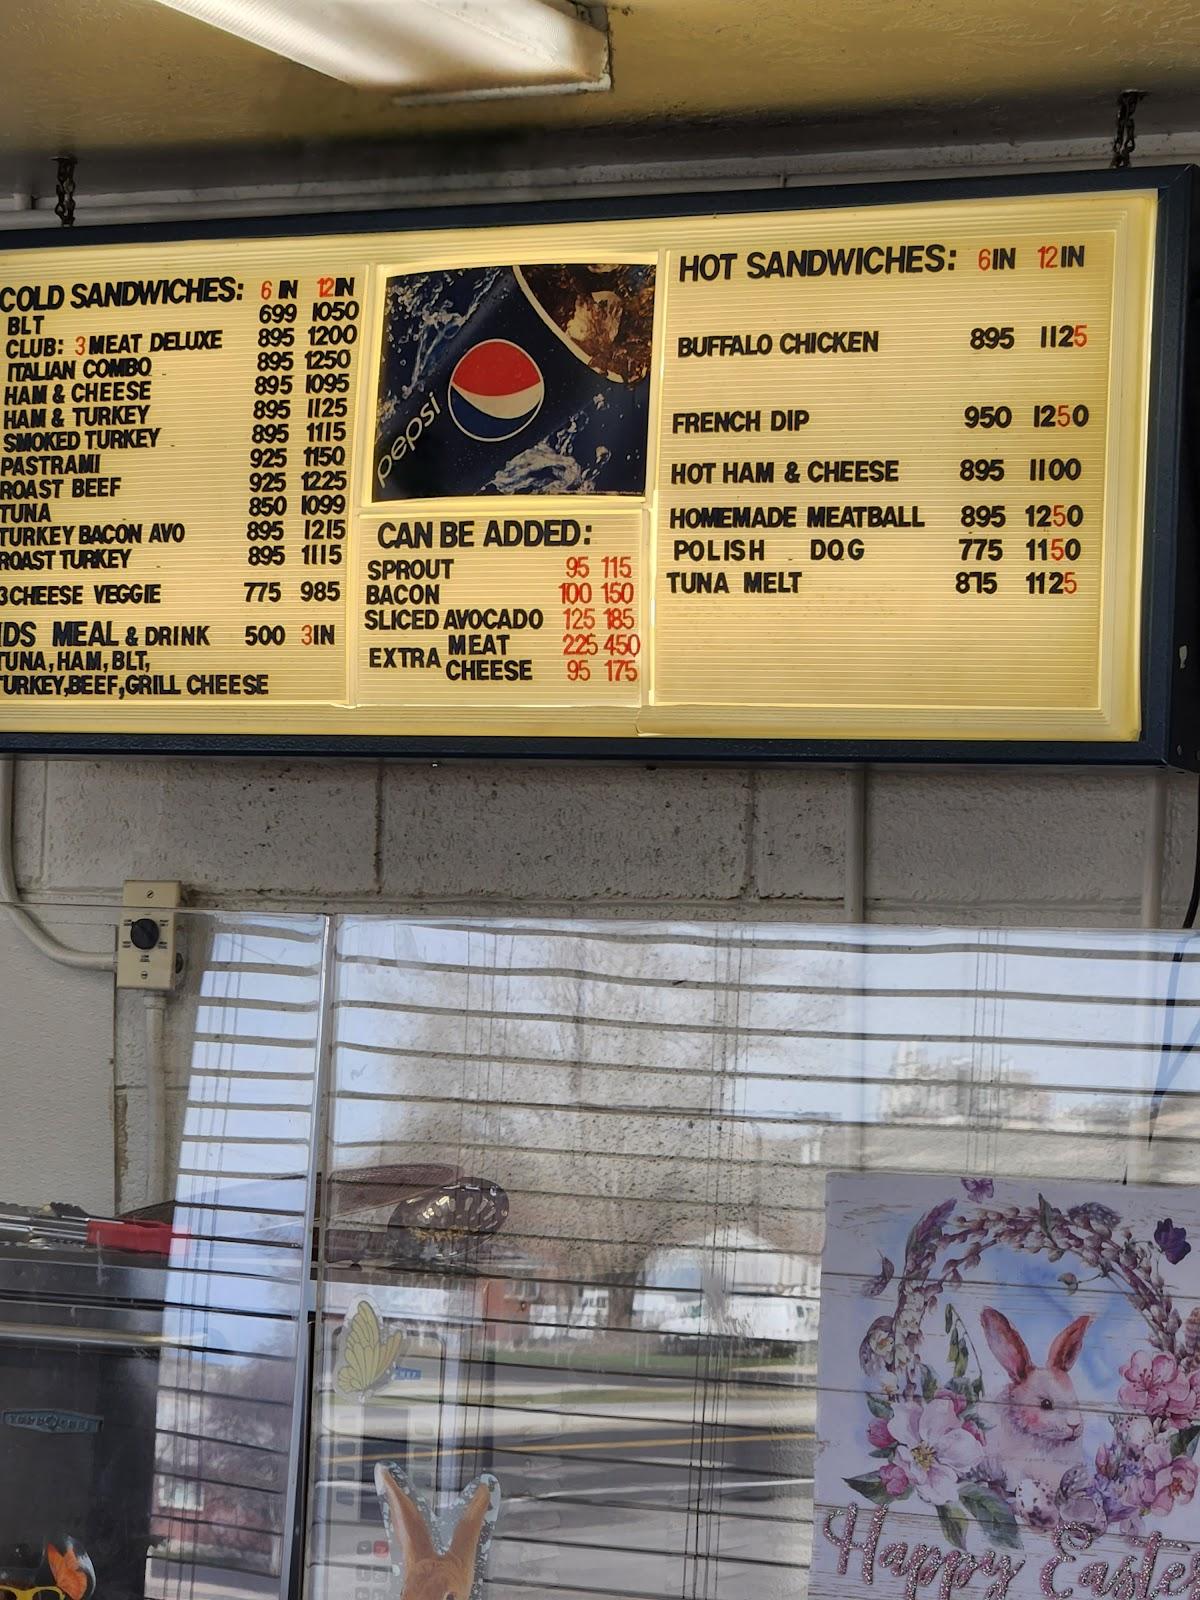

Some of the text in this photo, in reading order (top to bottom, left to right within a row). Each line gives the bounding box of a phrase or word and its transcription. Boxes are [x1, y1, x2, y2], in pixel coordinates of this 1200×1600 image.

[679, 243, 1085, 282] HOT SANDWICHES: 6IN 12IN
[0, 284, 65, 313] COLD
[70, 276, 244, 309] SANDWICHES:
[317, 276, 355, 299] 12IN
[7, 300, 360, 336] BLT 699 1050
[5, 337, 63, 360] CLUB:
[88, 333, 143, 355] MEAT
[149, 329, 223, 352] DELUXE
[257, 327, 295, 348] 895
[307, 324, 358, 346] 1200
[678, 323, 1089, 358] BUFFALO CHICKEN 895 1125
[7, 349, 351, 383] ITALIAN COMBO 895 1250
[4, 373, 350, 406] HAM & CHEESE 895 1095
[3, 397, 348, 430] HAM & TURKEY 895 1125
[672, 404, 1090, 434] FRENCH DIP 950 1250
[3, 421, 347, 453] SMOKED TURKEY 895 1115
[377, 391, 441, 489] pepsi
[0, 445, 346, 477] PASTRAMI 925 1150
[671, 458, 1082, 485] HOT HAM & CHEESE 895 1100
[0, 470, 347, 501] ROAST BEEF 925 1225
[0, 494, 346, 524] TUNA 850 1099
[670, 504, 1084, 529] HOMEMADE MEATBALL 895 1250
[0, 519, 346, 547] TURKEY BACON AVO 895 1215
[377, 519, 592, 549] CAN BE ADDED:
[0, 544, 342, 571] ROAST TURKEY 895 1115
[674, 537, 1081, 562] POLISH DOG 775 1150
[367, 555, 633, 581] SPROUT 95 115
[666, 571, 1077, 595] TUNA MELT 875 1125
[93, 583, 161, 605] VEGGIE
[243, 581, 282, 603] 775
[300, 581, 341, 602] 985
[366, 581, 635, 605] BACON 100 150
[52, 620, 119, 647] MEAL
[125, 626, 139, 647] &
[145, 625, 210, 646] DRINK
[245, 625, 286, 646] 500
[301, 624, 335, 645] 3IN
[364, 607, 636, 631] SLICED AVOCADO 125 185
[369, 647, 441, 668] EXTRA
[448, 633, 641, 657] MEAT 225 450
[186, 674, 269, 696] CHEESE
[445, 659, 640, 682] CHEESE 95 175
[823, 1502, 1026, 1600] Happy
